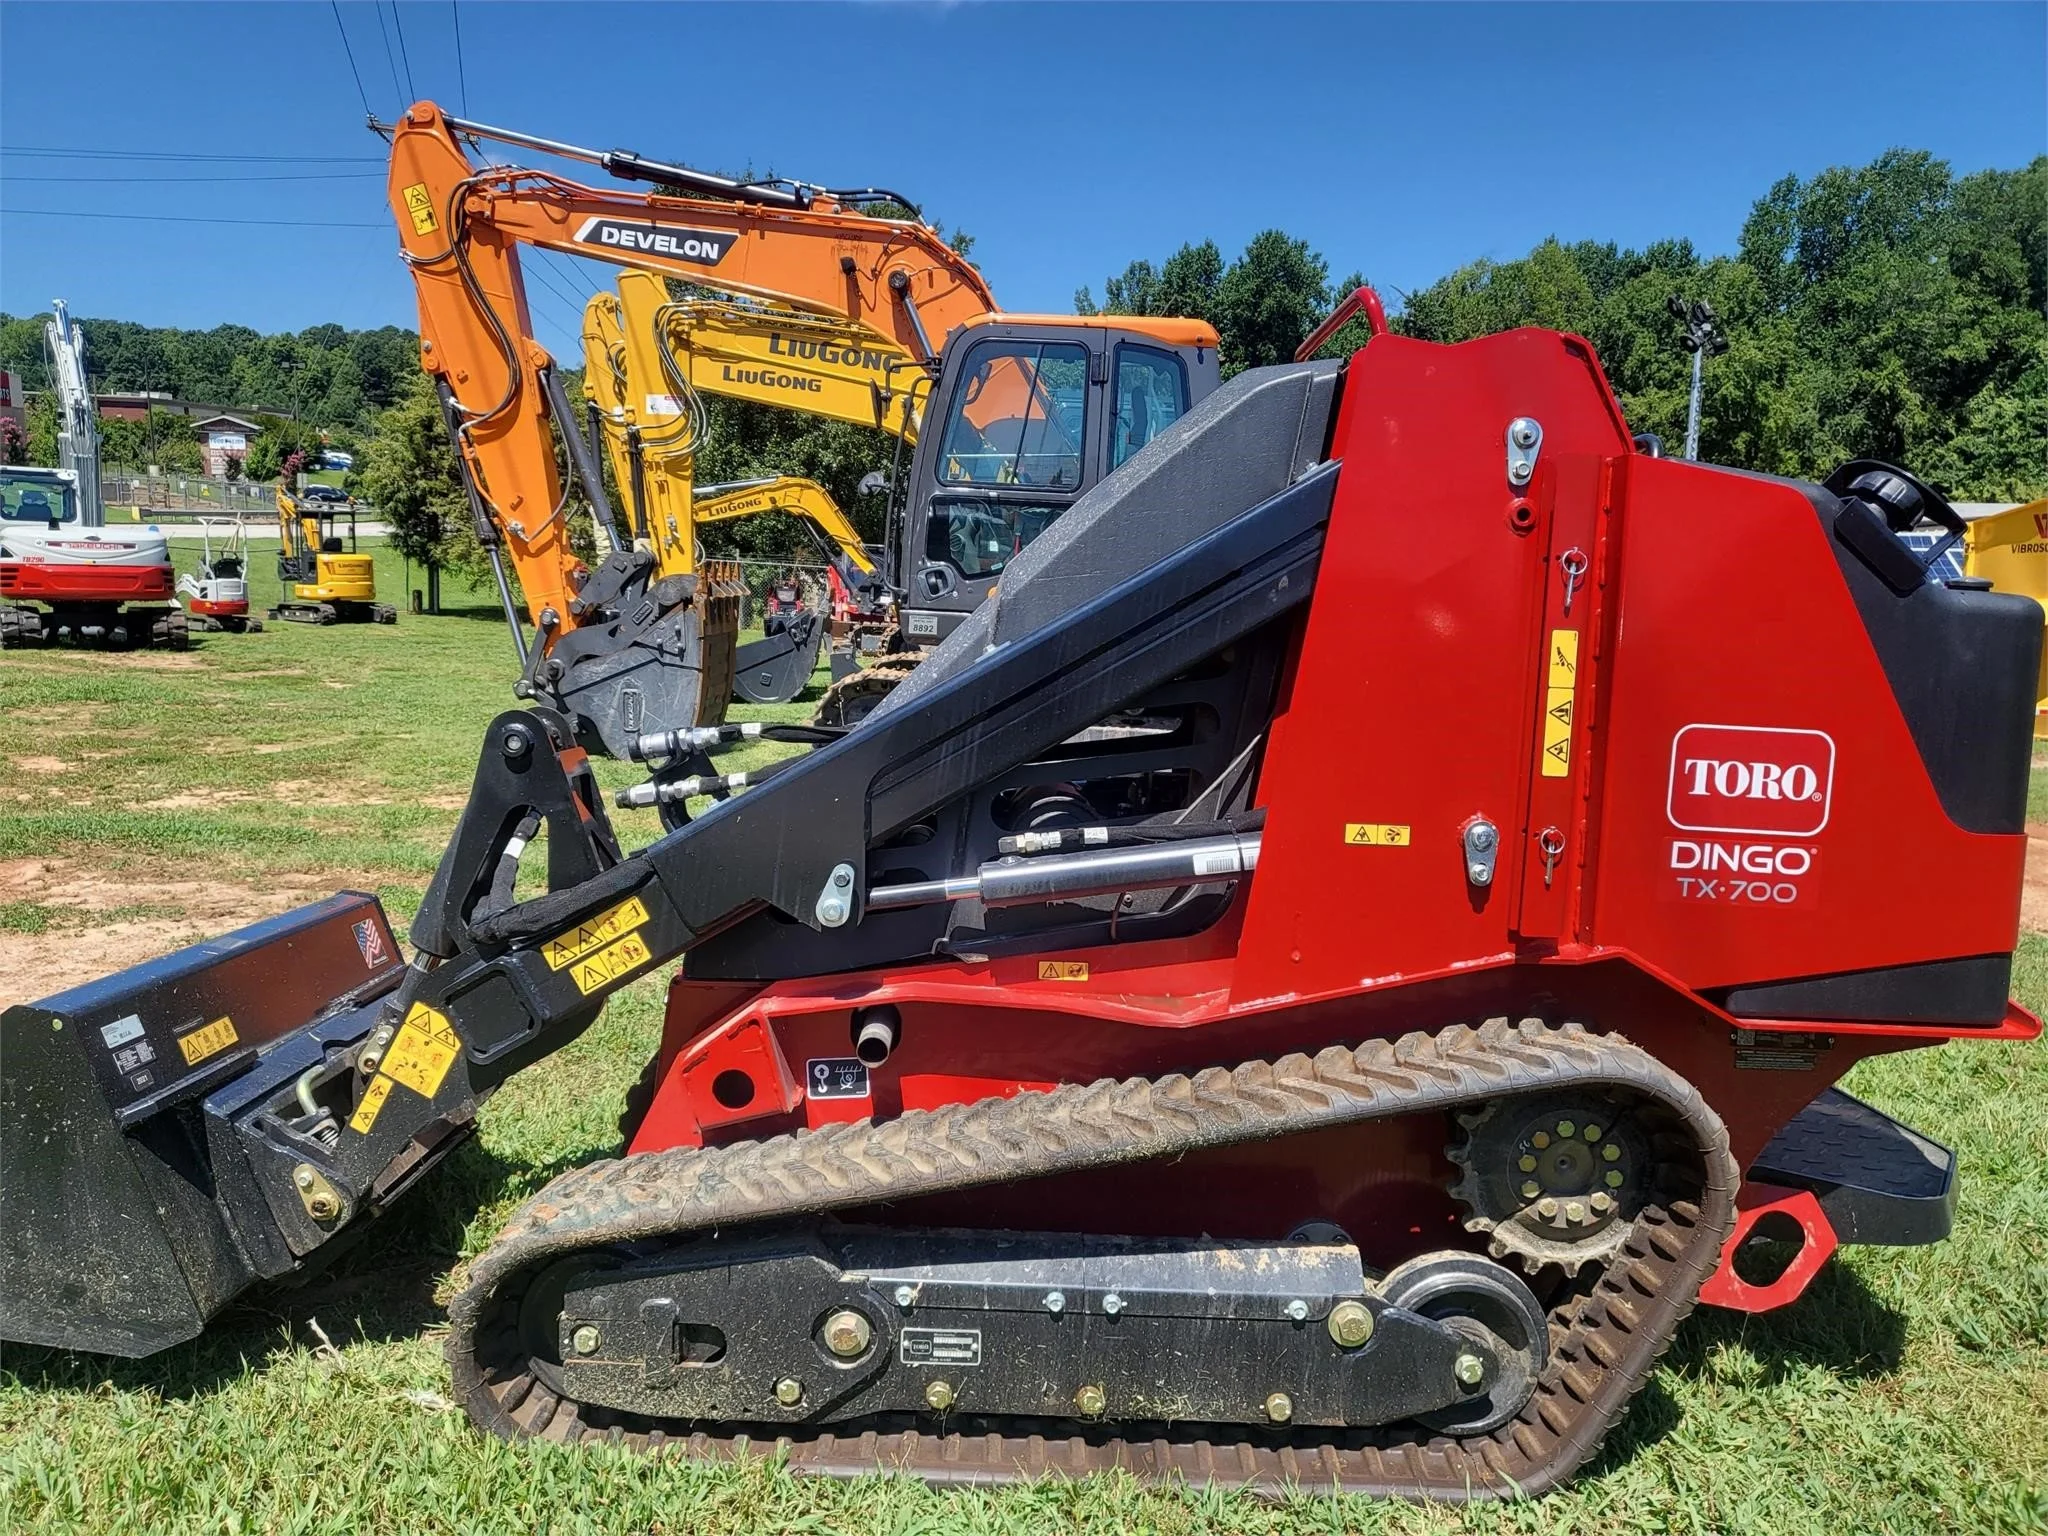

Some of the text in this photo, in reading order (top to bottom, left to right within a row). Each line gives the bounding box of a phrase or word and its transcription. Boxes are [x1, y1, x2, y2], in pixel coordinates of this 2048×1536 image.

[601, 226, 719, 259] DEVELON
[912, 623, 935, 633] 8892
[1684, 758, 1818, 801] TORO
[1670, 840, 1811, 876] DINGO
